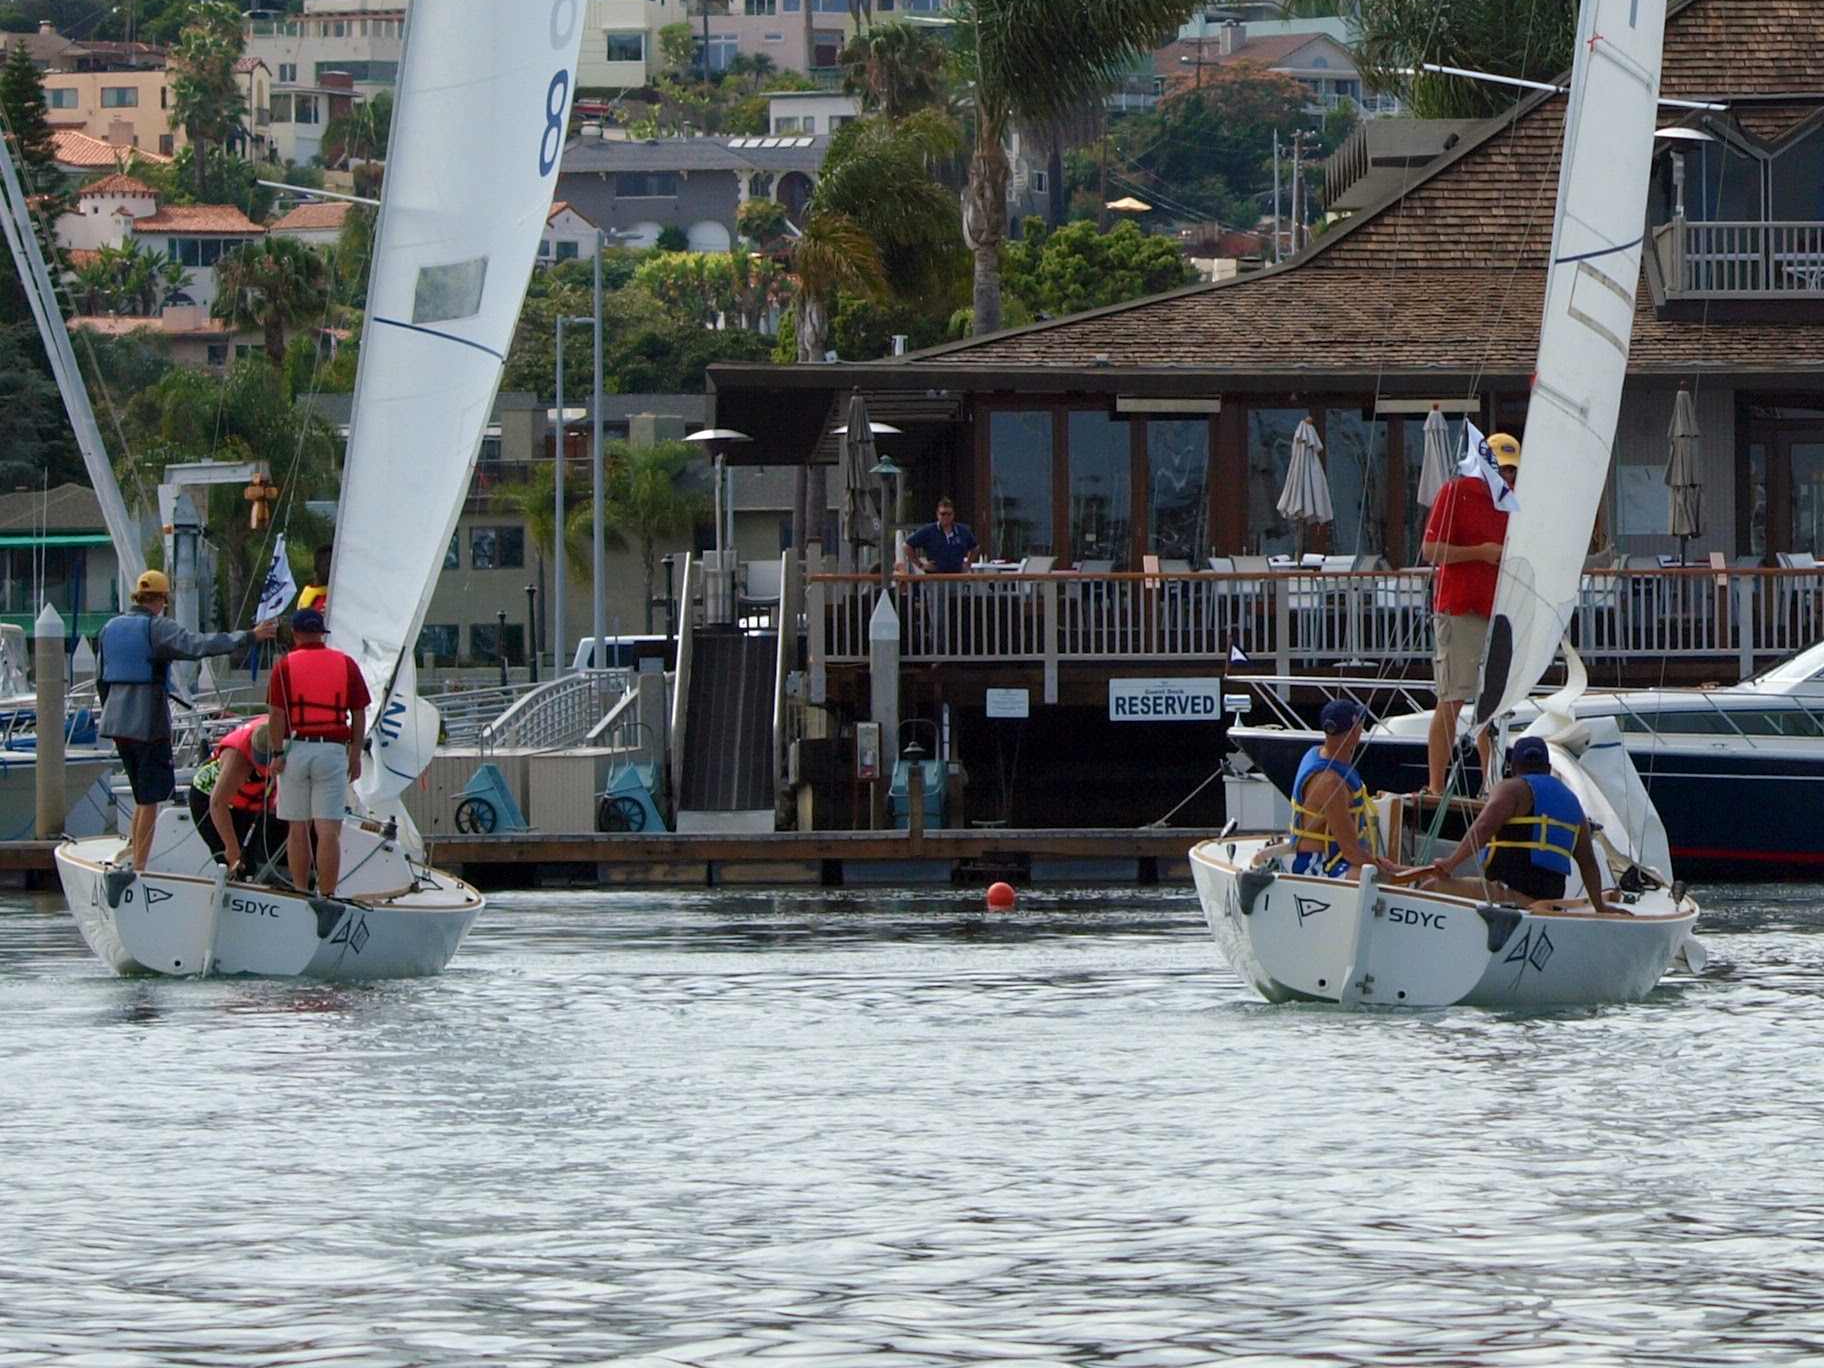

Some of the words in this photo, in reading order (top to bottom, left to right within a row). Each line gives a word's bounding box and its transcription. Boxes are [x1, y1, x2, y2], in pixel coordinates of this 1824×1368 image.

[539, 69, 569, 177] 8
[1115, 695, 1215, 715] RESERVED
[124, 889, 134, 903] D
[231, 898, 280, 919] SDYC
[1388, 907, 1448, 930] SDYC
